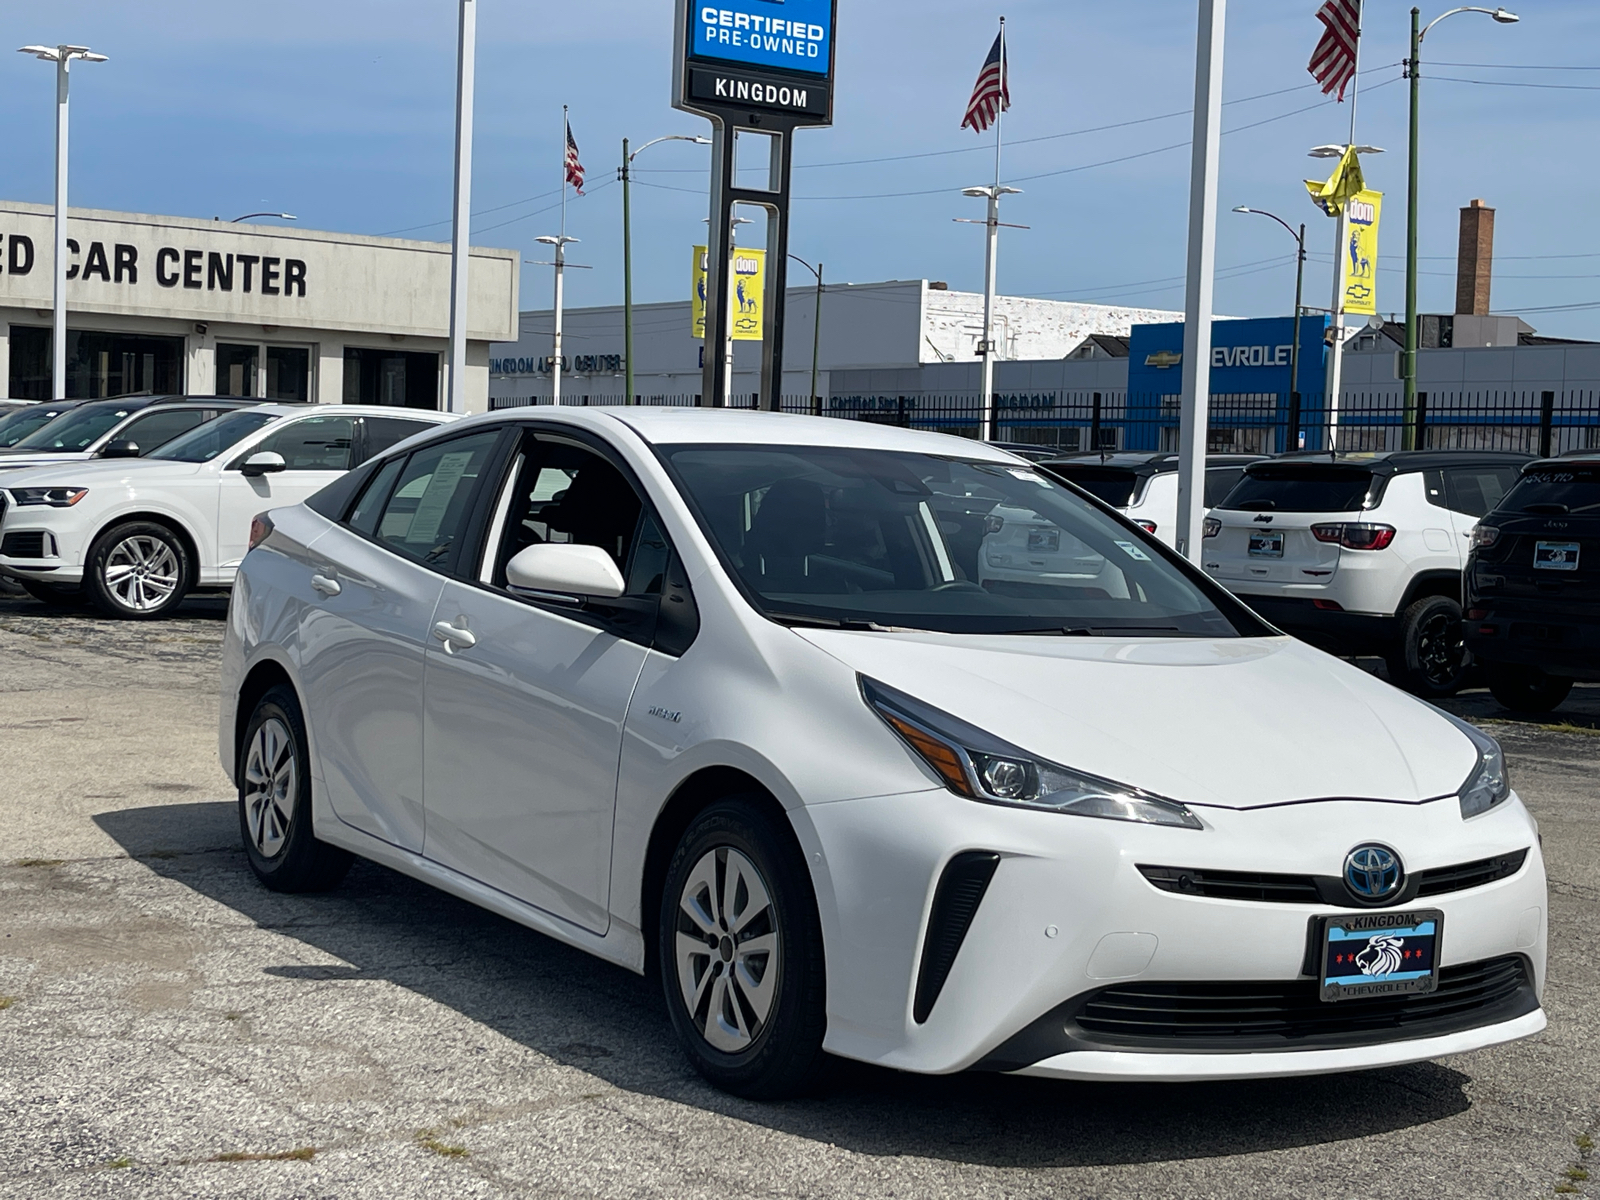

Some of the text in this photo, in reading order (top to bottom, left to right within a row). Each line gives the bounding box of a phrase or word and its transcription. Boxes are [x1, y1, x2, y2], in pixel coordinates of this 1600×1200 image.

[701, 7, 824, 41] CERTIFIED
[706, 26, 818, 58] PRE-OWNED
[715, 77, 807, 107] KINGDOM
[1350, 197, 1374, 223] dom
[0, 233, 307, 297] D CAR CENTER
[735, 255, 758, 274] dom
[574, 353, 621, 373] CENTER
[1211, 345, 1301, 367] EVROLET
[997, 395, 1055, 411] NGDOM
[1253, 513, 1274, 524] Jeep
[1354, 914, 1415, 929] KINGDOM
[1347, 982, 1409, 996] CHEVROLET
